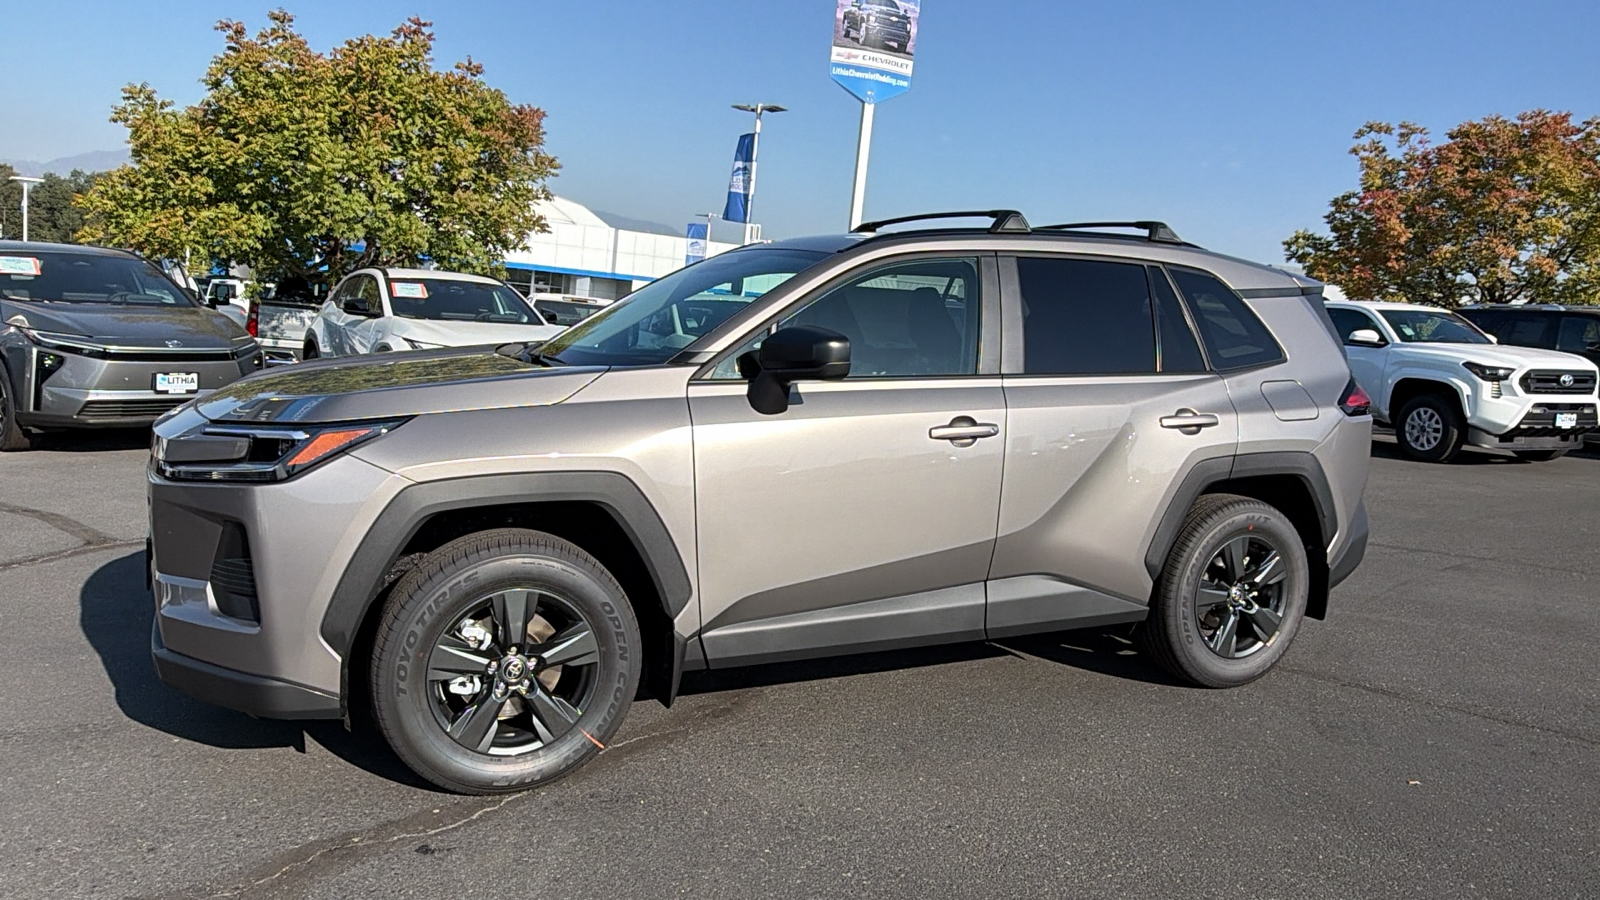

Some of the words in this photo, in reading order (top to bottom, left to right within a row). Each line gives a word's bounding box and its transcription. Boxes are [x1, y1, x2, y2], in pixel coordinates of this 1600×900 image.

[832, 66, 908, 87] LithiaChevroletRedding.com
[862, 54, 909, 70] CHEVROLET
[167, 376, 195, 384] LITHIA
[396, 629, 419, 698] TOYO
[415, 570, 479, 629] TIRES
[600, 601, 629, 663] OPEN
[1182, 595, 1194, 645] OPEN
